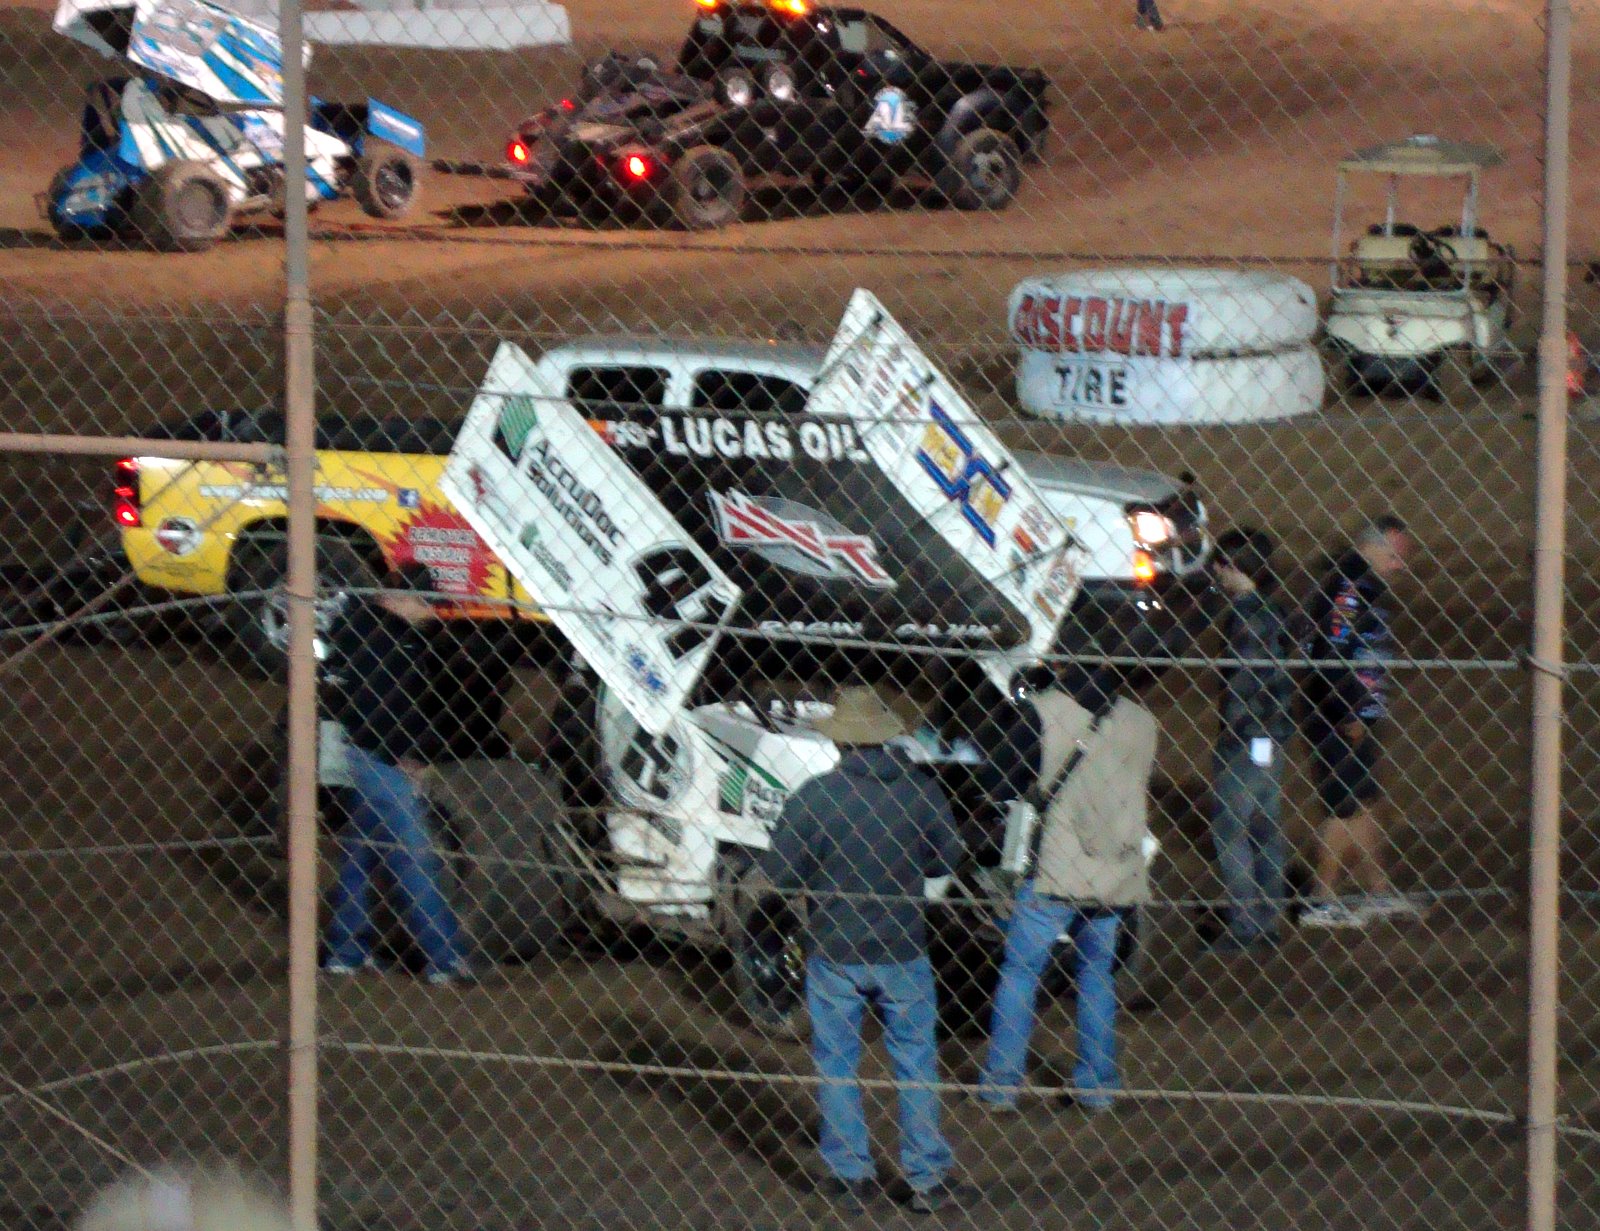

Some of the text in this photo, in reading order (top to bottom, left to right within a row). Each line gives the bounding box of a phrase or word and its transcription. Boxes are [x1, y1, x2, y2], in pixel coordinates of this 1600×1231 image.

[1054, 365, 1128, 405] TIRE
[660, 415, 793, 462] LUCAS
[800, 421, 870, 464] OIL
